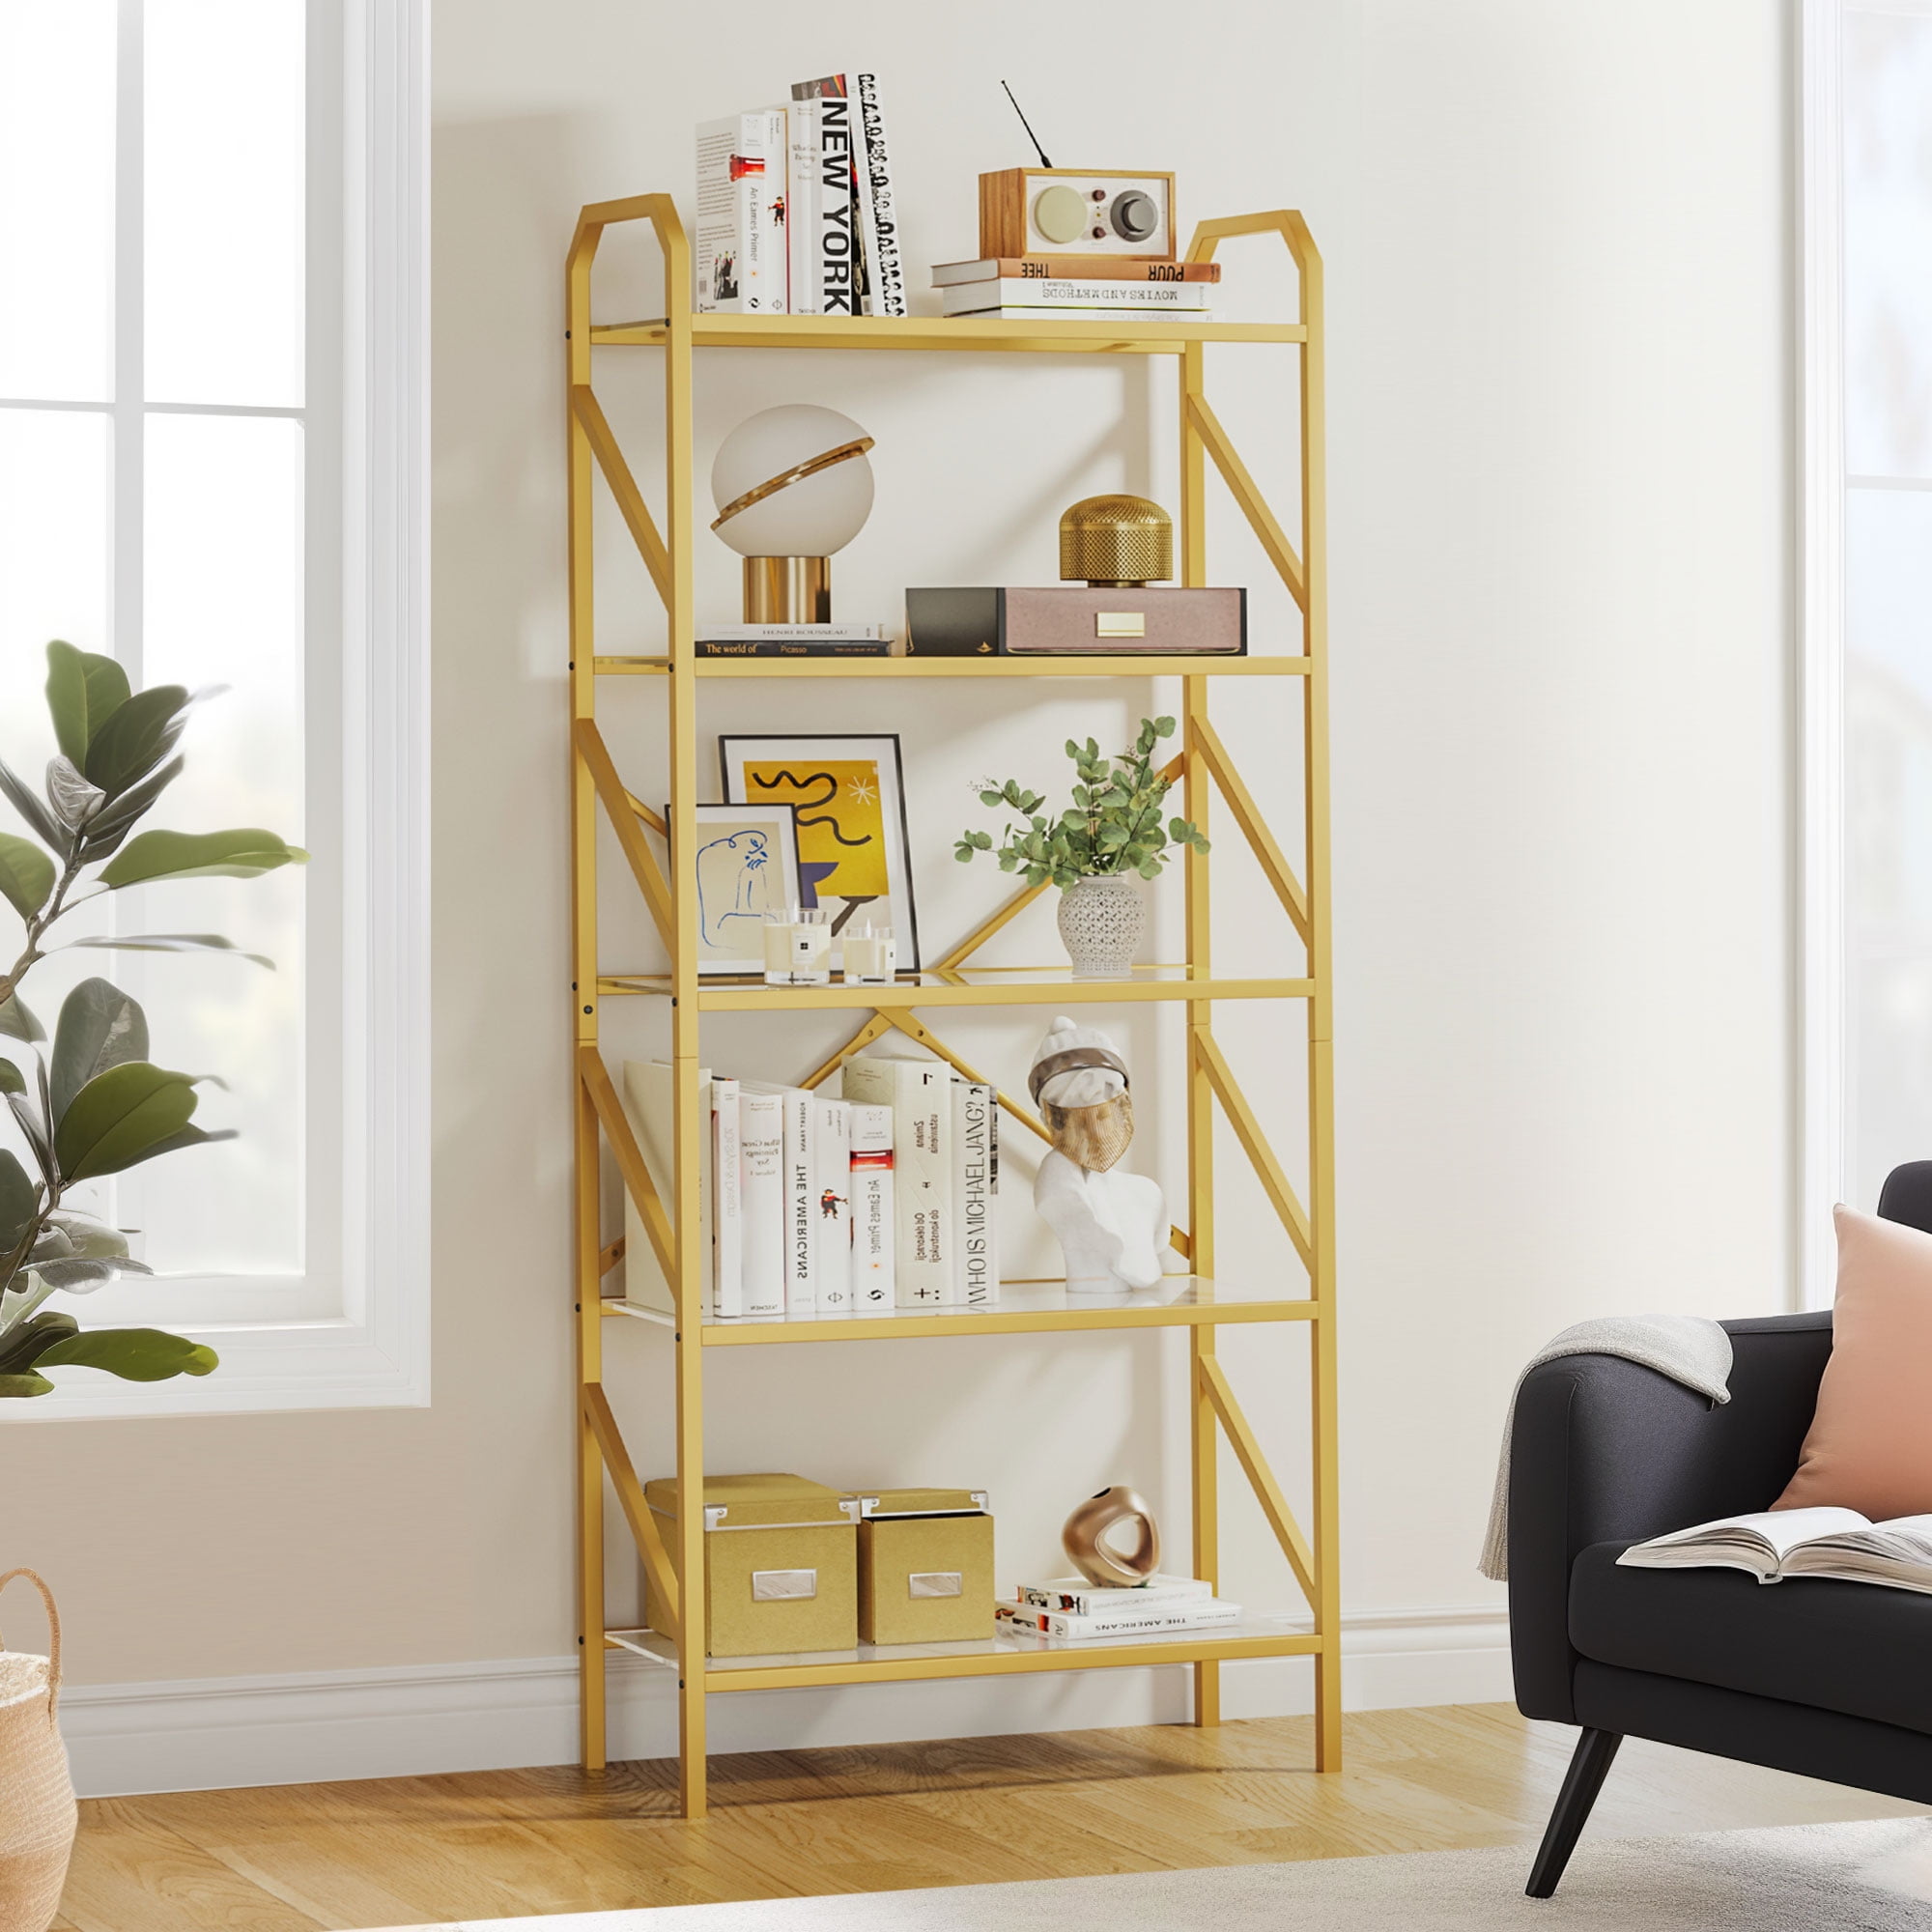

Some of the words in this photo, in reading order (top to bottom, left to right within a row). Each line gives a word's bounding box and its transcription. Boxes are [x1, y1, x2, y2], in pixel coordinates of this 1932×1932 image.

[821, 100, 850, 191] NEW
[749, 187, 759, 199] An
[749, 201, 759, 231] Eames
[750, 233, 759, 262] Primer
[822, 204, 851, 313] YORK
[1021, 263, 1050, 278] THEE
[1148, 266, 1184, 282] PUUR
[1041, 288, 1099, 299] METHODS
[1100, 289, 1127, 299] AND
[1129, 289, 1178, 300] MOVIES
[706, 643, 723, 654] The
[723, 643, 746, 654] world
[748, 643, 757, 654] of
[780, 645, 808, 654] Picasso
[965, 1101, 985, 1155] JANG?
[965, 1157, 985, 1236] MICHAEL
[967, 1239, 985, 1254] IS
[967, 1258, 987, 1304] WHO
[1094, 1618, 1162, 1631] AMERICANS
[1165, 1617, 1186, 1626] THE
